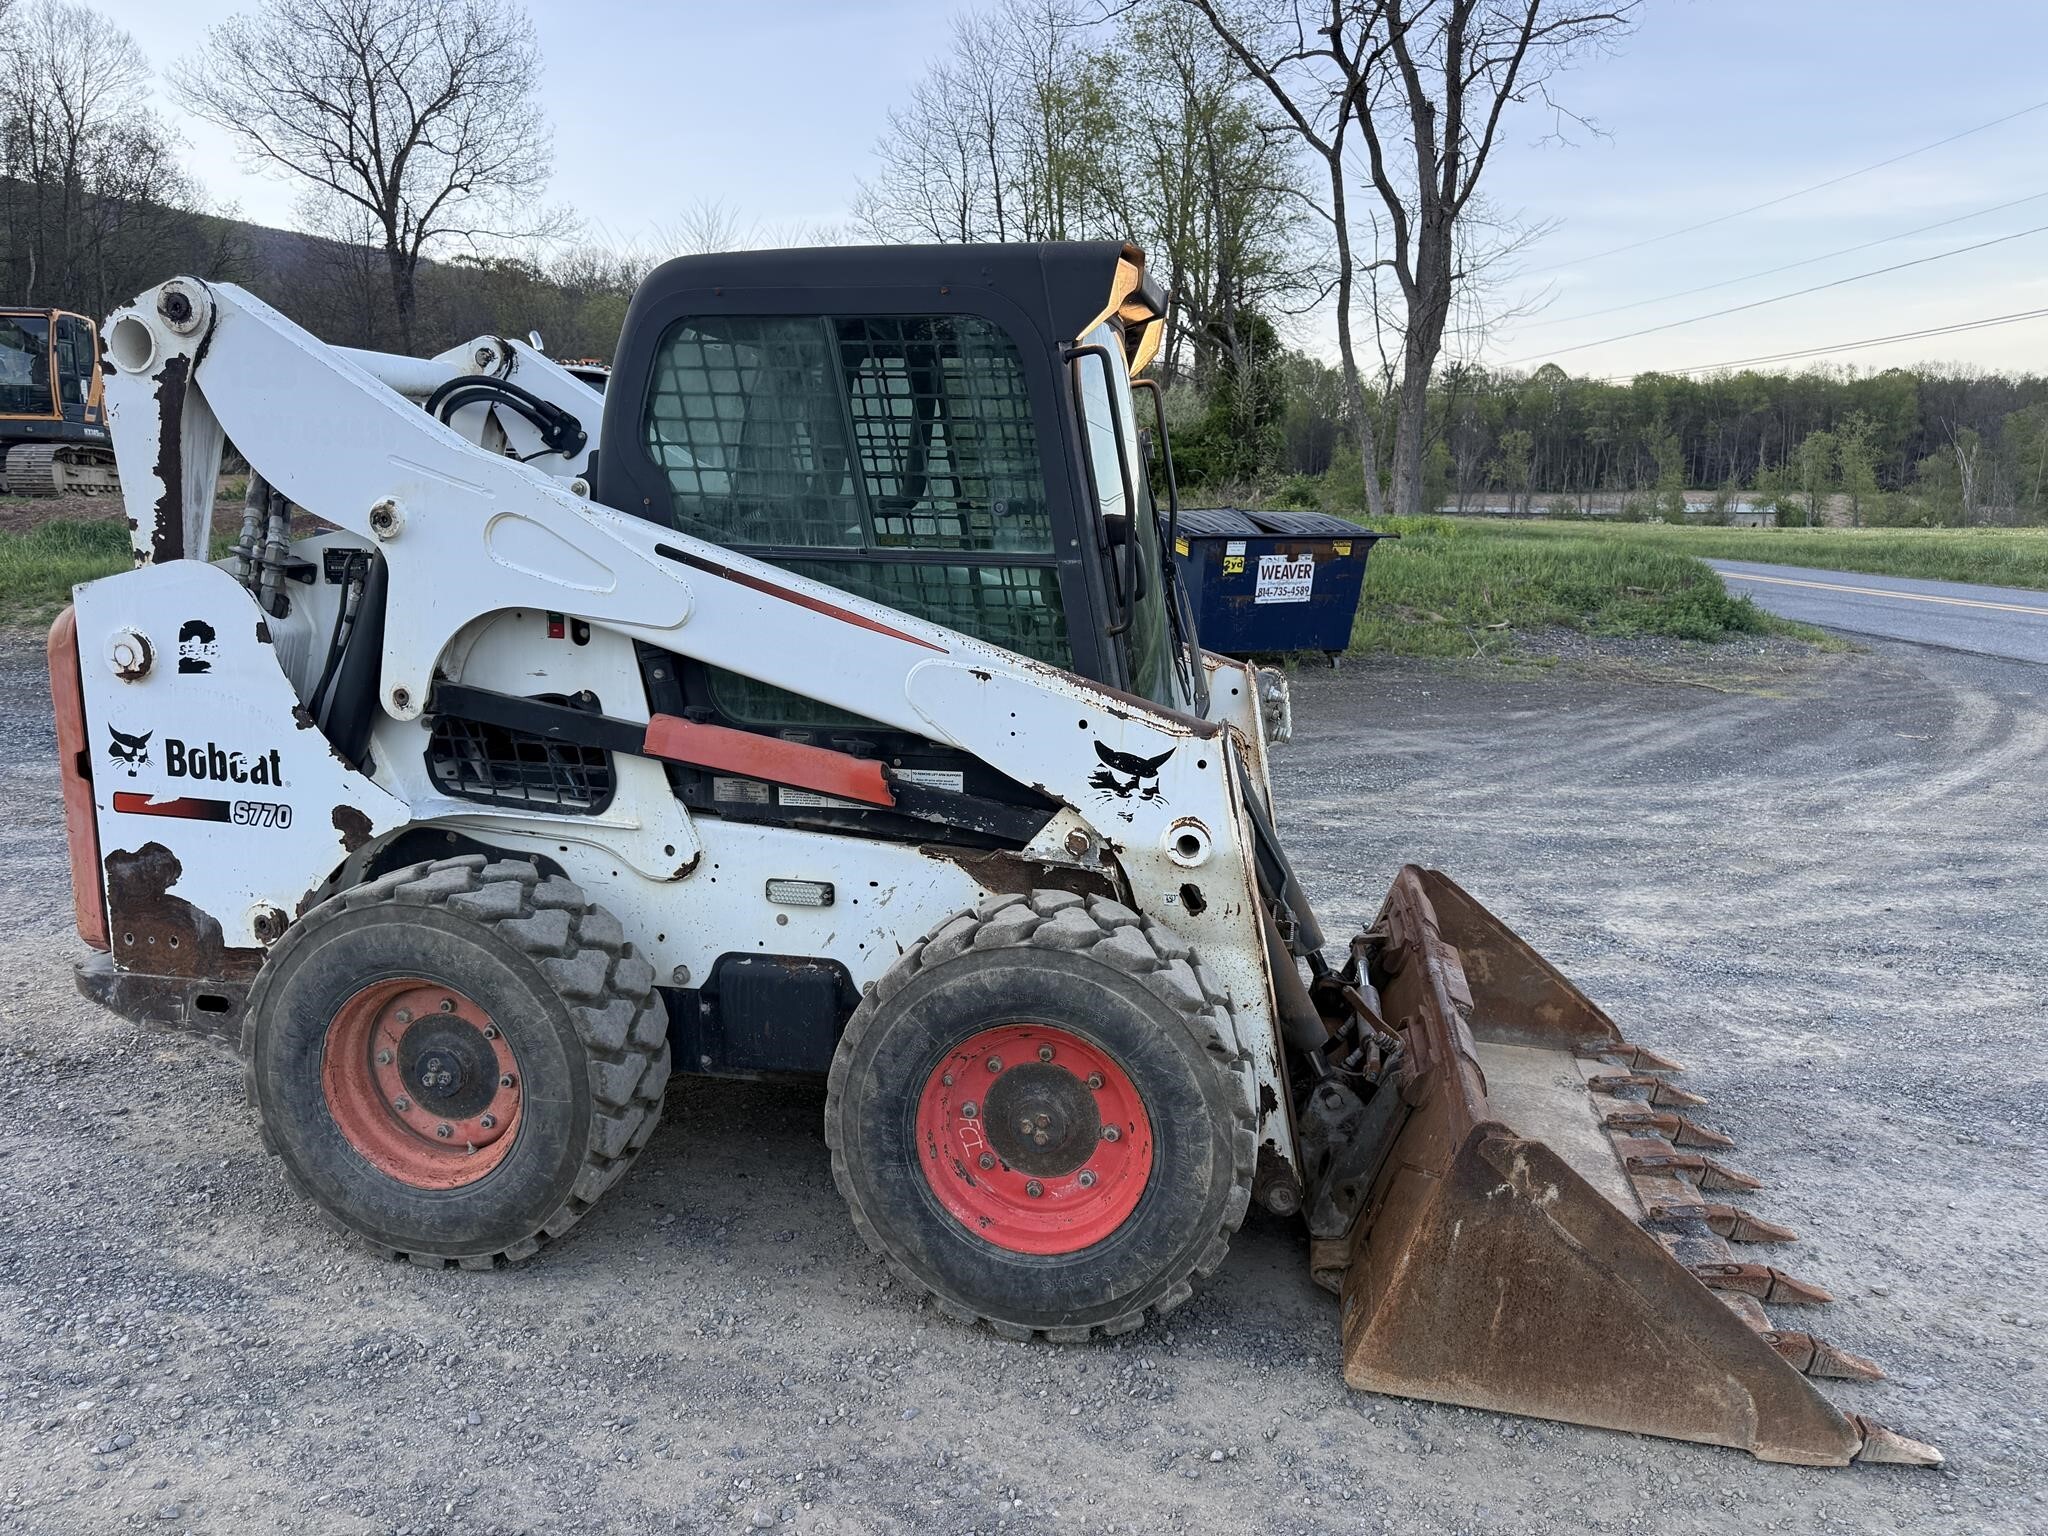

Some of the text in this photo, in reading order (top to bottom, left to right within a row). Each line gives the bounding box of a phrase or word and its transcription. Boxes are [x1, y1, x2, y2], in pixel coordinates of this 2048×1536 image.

[1224, 560, 1244, 571] 2yd
[1261, 564, 1312, 580] WEAVER
[1257, 586, 1310, 598] 814-735-4589
[165, 738, 283, 787] Bobcat
[233, 800, 292, 829] S770
